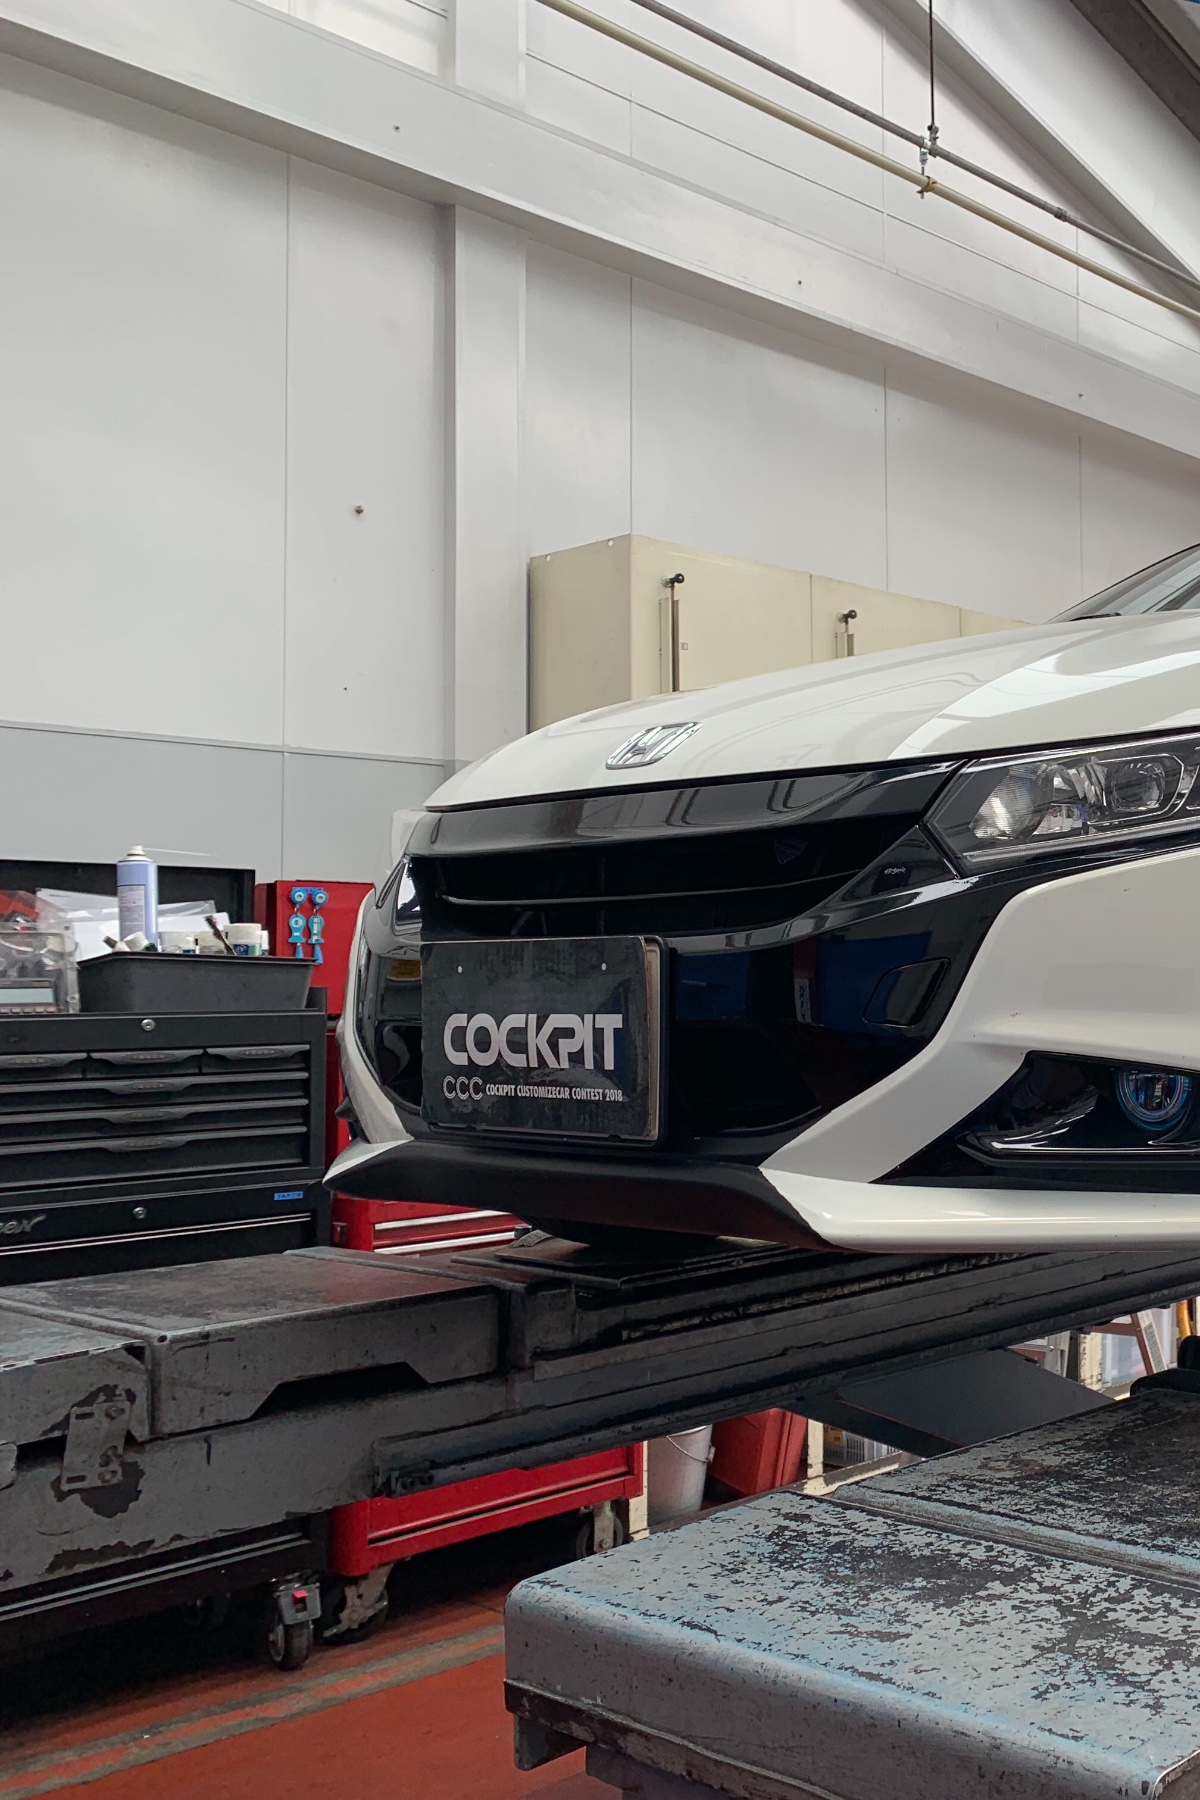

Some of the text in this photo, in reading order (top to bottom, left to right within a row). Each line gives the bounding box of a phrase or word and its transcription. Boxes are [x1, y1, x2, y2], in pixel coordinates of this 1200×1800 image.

[443, 1012, 623, 1070] COCKPIT
[442, 1075, 623, 1102] CCC COCKPIT CUSTOMIZECAR CONTEST 2018
